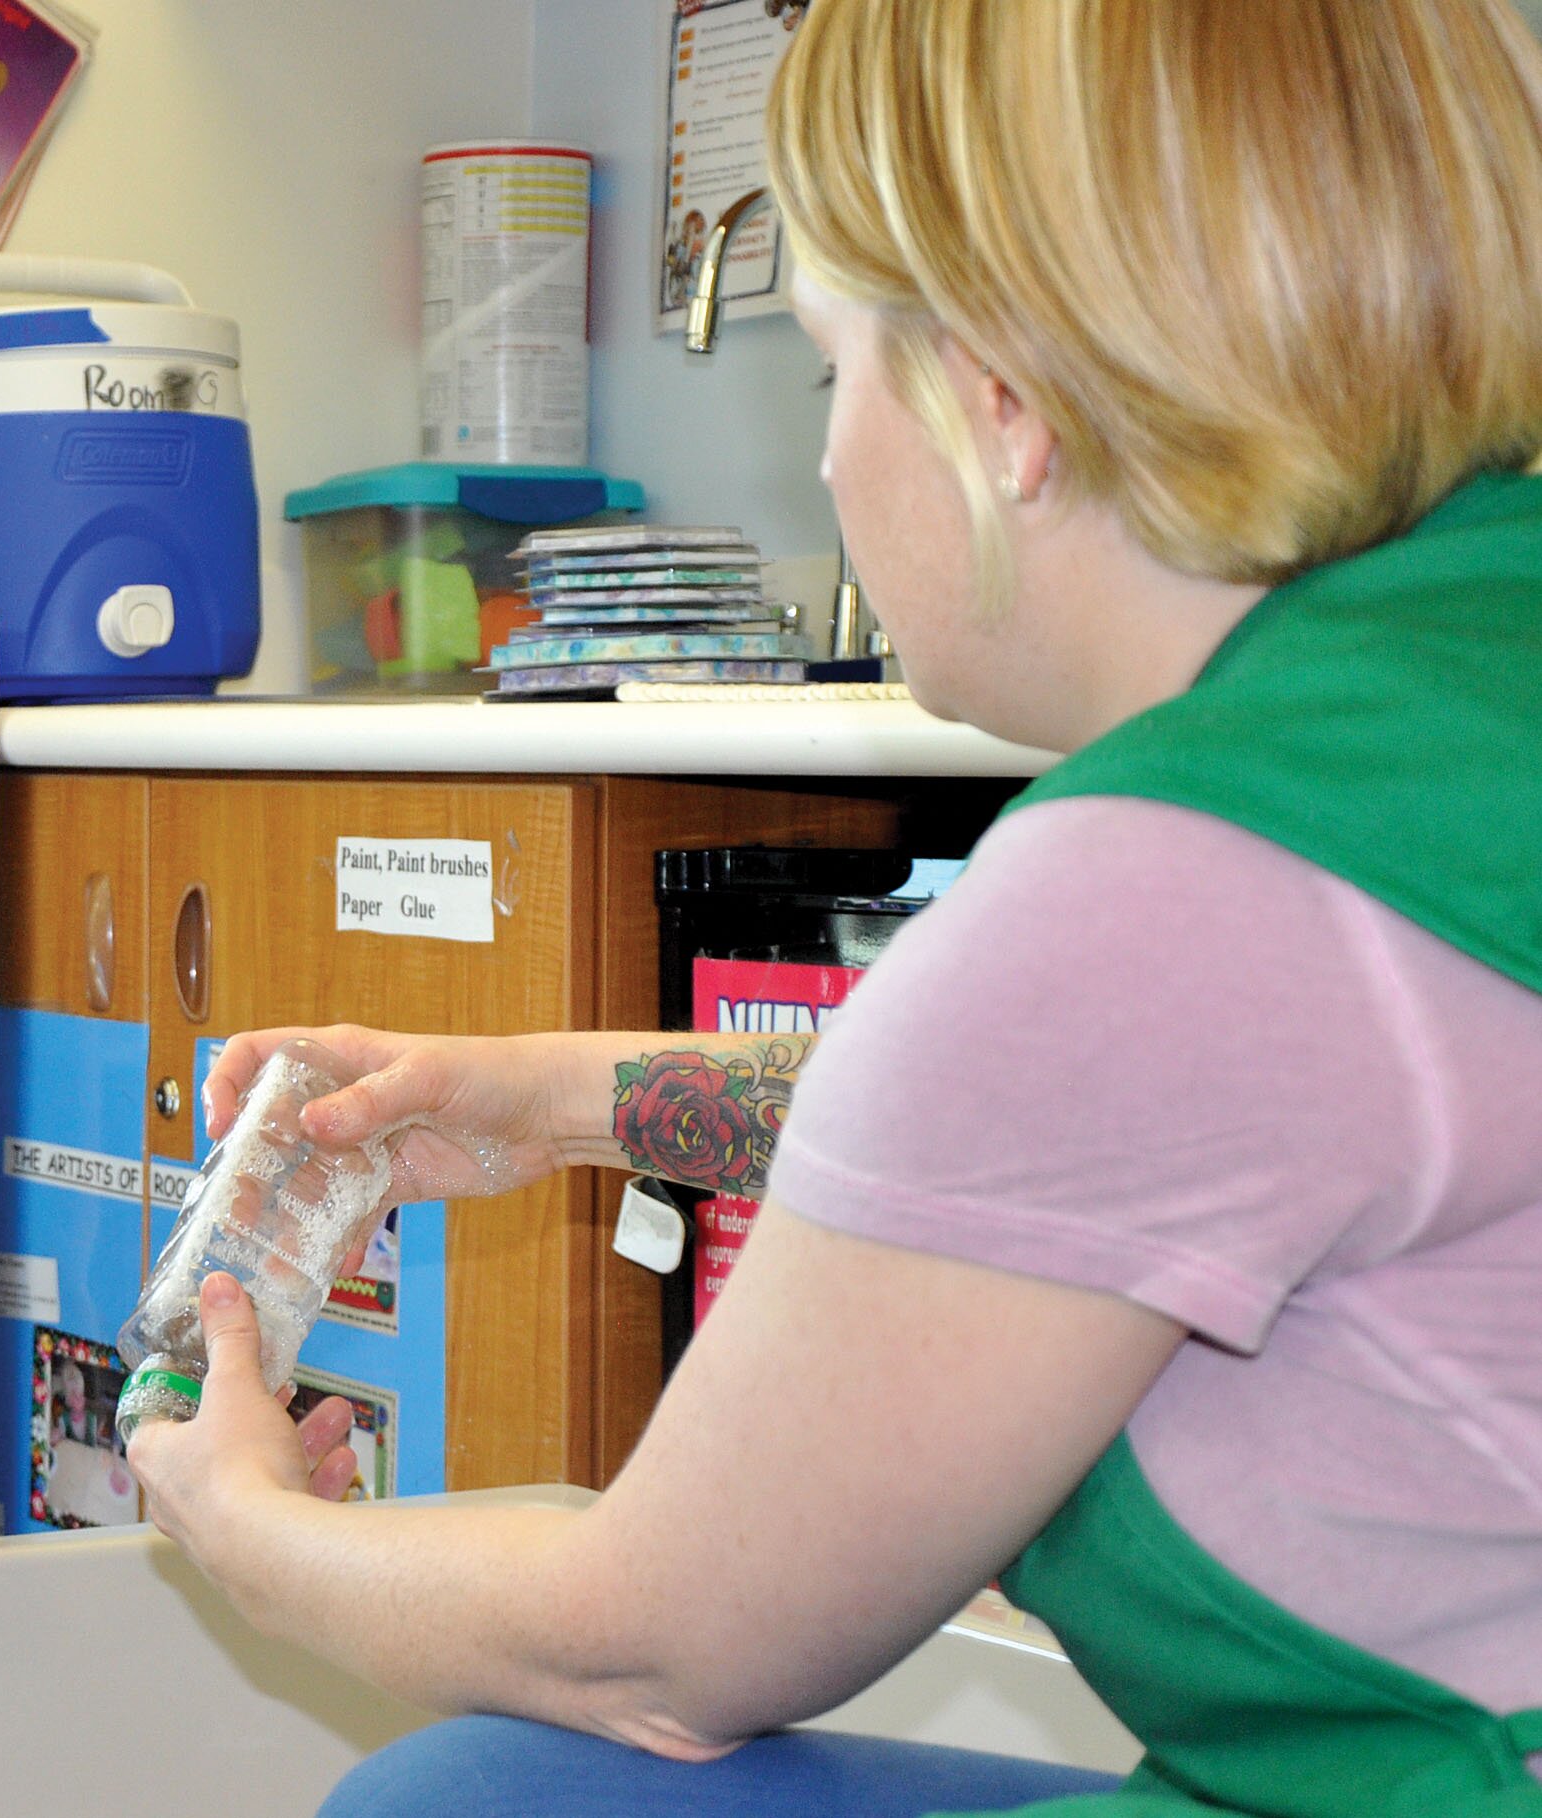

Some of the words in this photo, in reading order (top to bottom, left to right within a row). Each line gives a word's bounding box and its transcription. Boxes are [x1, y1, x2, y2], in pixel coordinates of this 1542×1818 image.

[83, 364, 164, 411] Room
[341, 847, 382, 874] Paint,
[388, 849, 426, 873] Paint
[431, 852, 488, 878] brushes
[341, 892, 382, 921] Paper
[401, 894, 436, 919] Glue
[13, 1145, 40, 1171] THE
[48, 1155, 113, 1186] ARTISTS
[119, 1167, 139, 1191] OF
[155, 1171, 191, 1199] ROO
